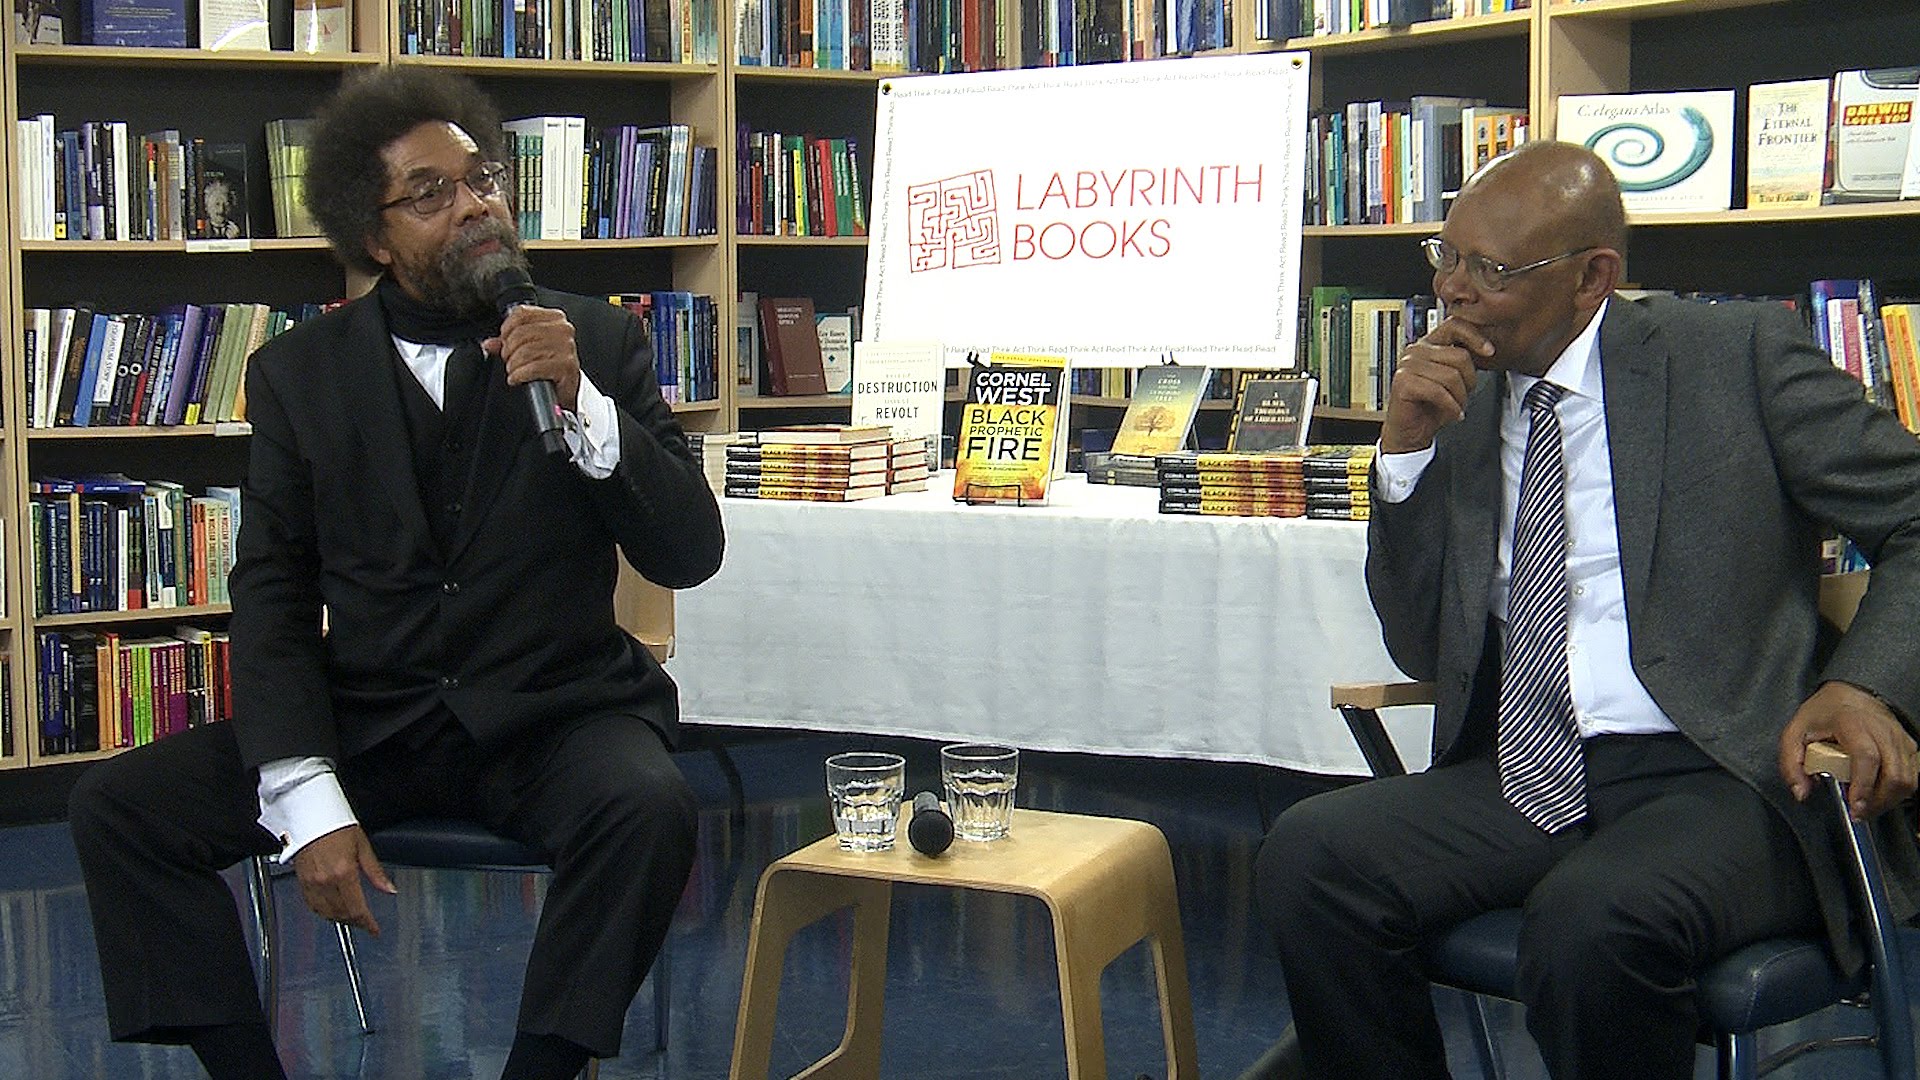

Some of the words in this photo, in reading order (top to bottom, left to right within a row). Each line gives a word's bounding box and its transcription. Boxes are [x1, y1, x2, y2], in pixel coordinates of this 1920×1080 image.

[1640, 102, 1671, 115] Atlas
[1846, 102, 1910, 117] DARWIN
[1845, 115, 1882, 125] LOVES
[1885, 114, 1910, 124] YOU
[1758, 132, 1818, 146] FRONTIER
[1016, 163, 1263, 211] LABYRINTH
[1012, 218, 1171, 261] BOOKS
[858, 380, 938, 394] DESTRUCTION
[976, 372, 1052, 387] CORNEL
[975, 386, 1051, 405] WEST
[876, 406, 920, 419] REVOLT
[971, 409, 1046, 426] BLACK
[969, 425, 1044, 437] PROPHETIC
[966, 437, 1043, 461] FIRE
